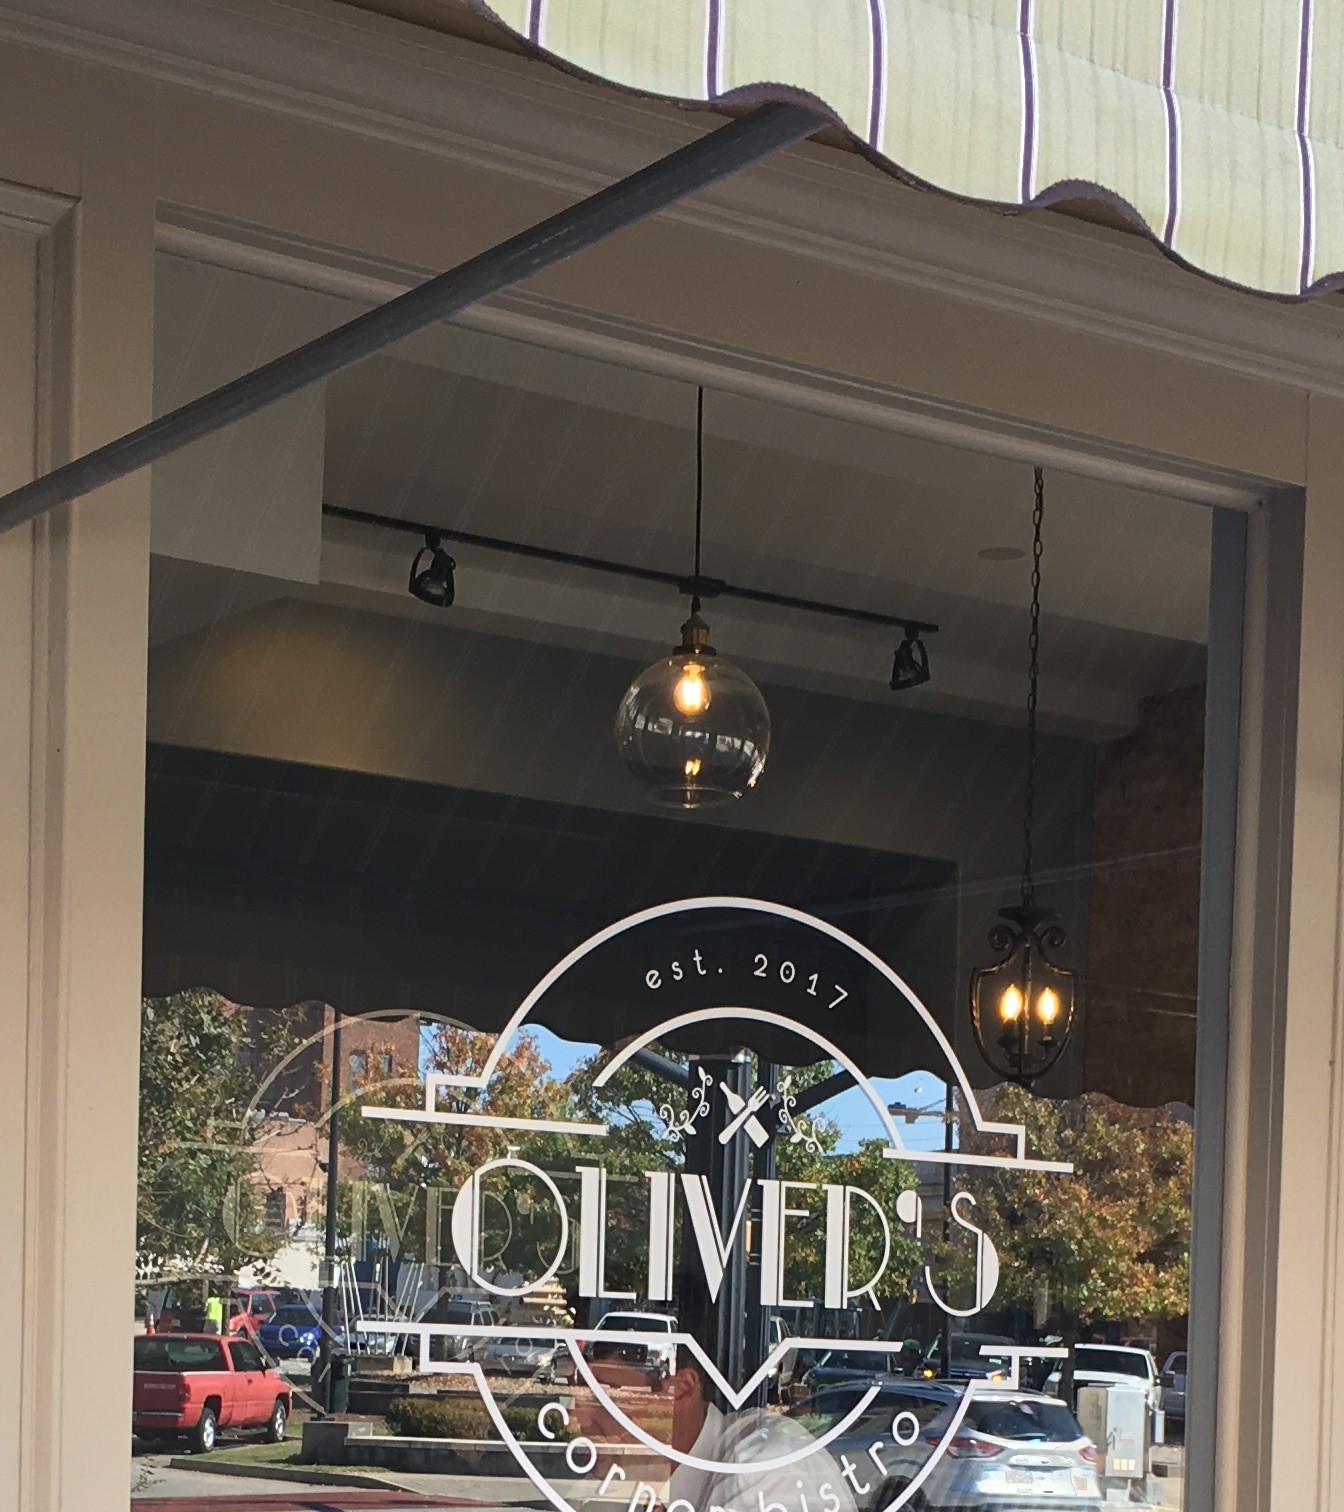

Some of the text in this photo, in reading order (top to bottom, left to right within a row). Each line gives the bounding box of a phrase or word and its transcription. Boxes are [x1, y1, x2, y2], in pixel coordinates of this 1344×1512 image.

[645, 949, 849, 1009] est. 2017
[451, 1154, 999, 1317] OLIVER'S
